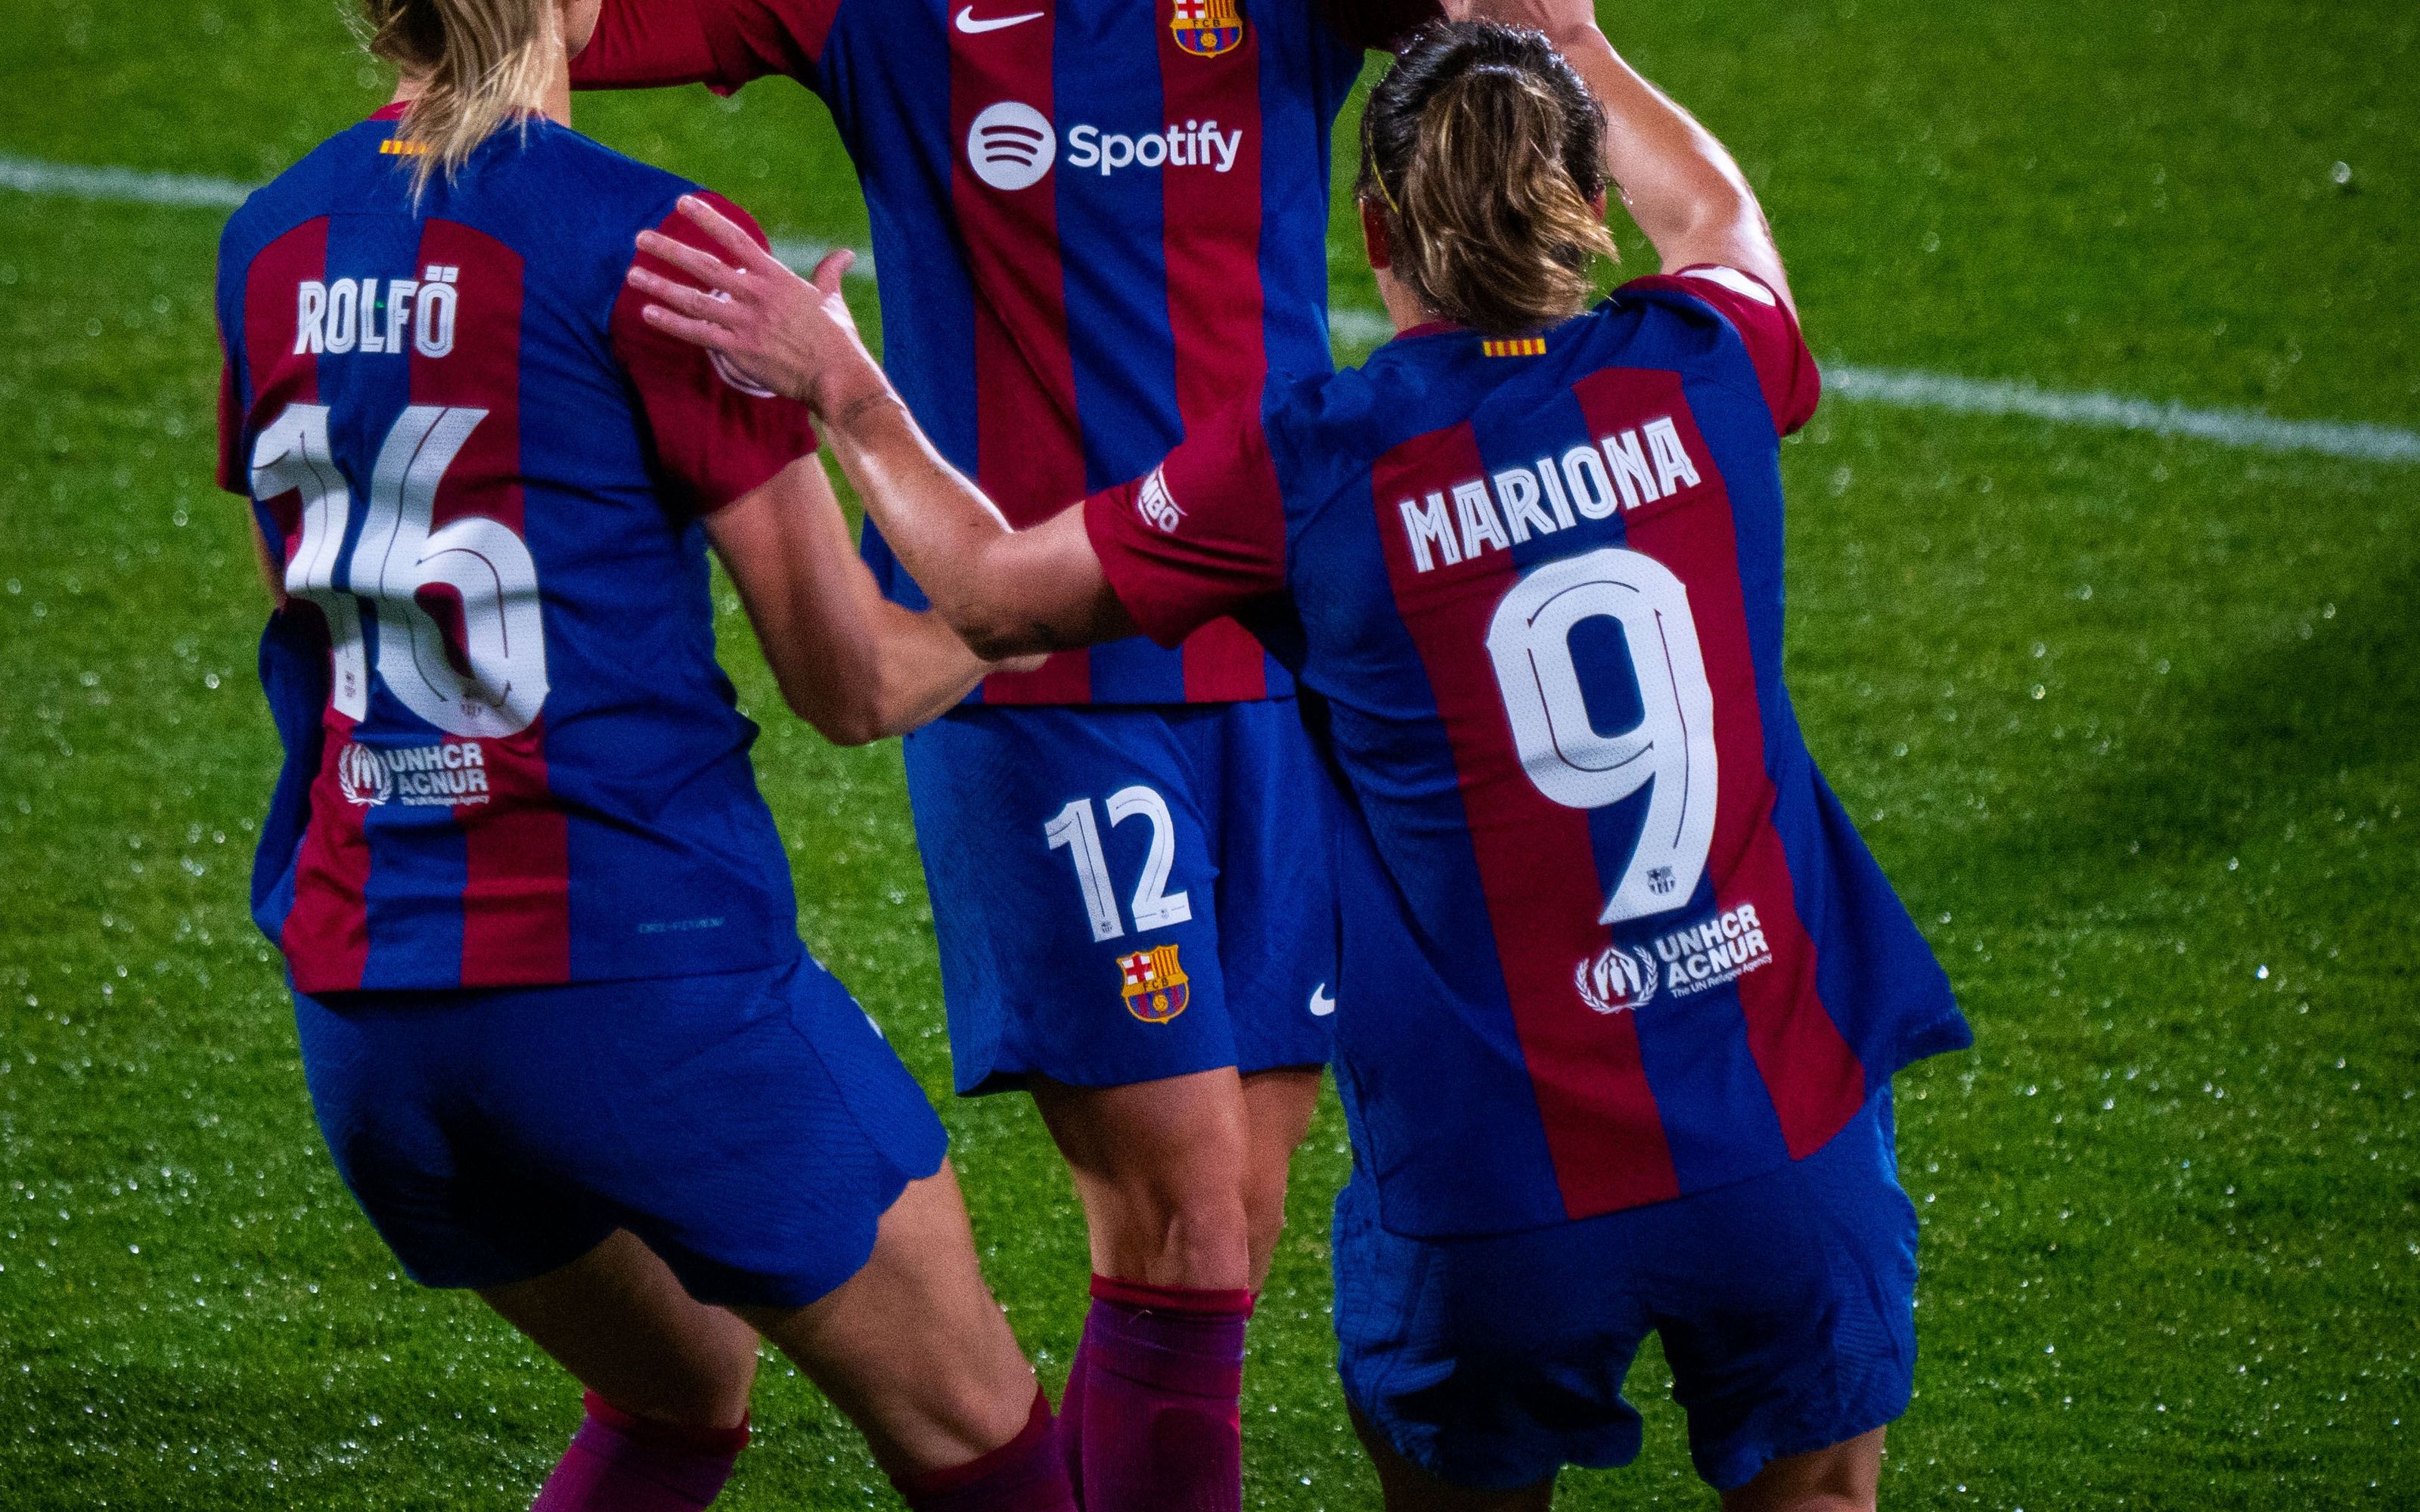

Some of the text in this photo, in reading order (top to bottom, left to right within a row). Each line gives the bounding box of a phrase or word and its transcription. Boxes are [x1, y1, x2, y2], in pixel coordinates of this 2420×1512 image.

[1193, 19, 1221, 28] FCB
[1068, 119, 1243, 175] Spotify
[293, 265, 459, 358] ROLFÖ
[1399, 416, 1701, 573] MARIONA
[250, 403, 551, 739] 16
[385, 742, 484, 772] UNHCR
[1485, 548, 1718, 925] 9
[397, 768, 489, 795] ACNUR
[1044, 785, 1192, 943] 12
[1655, 903, 1761, 962] UNHCR
[1668, 929, 1769, 988] ACNUR
[1143, 977, 1169, 992] FCB
